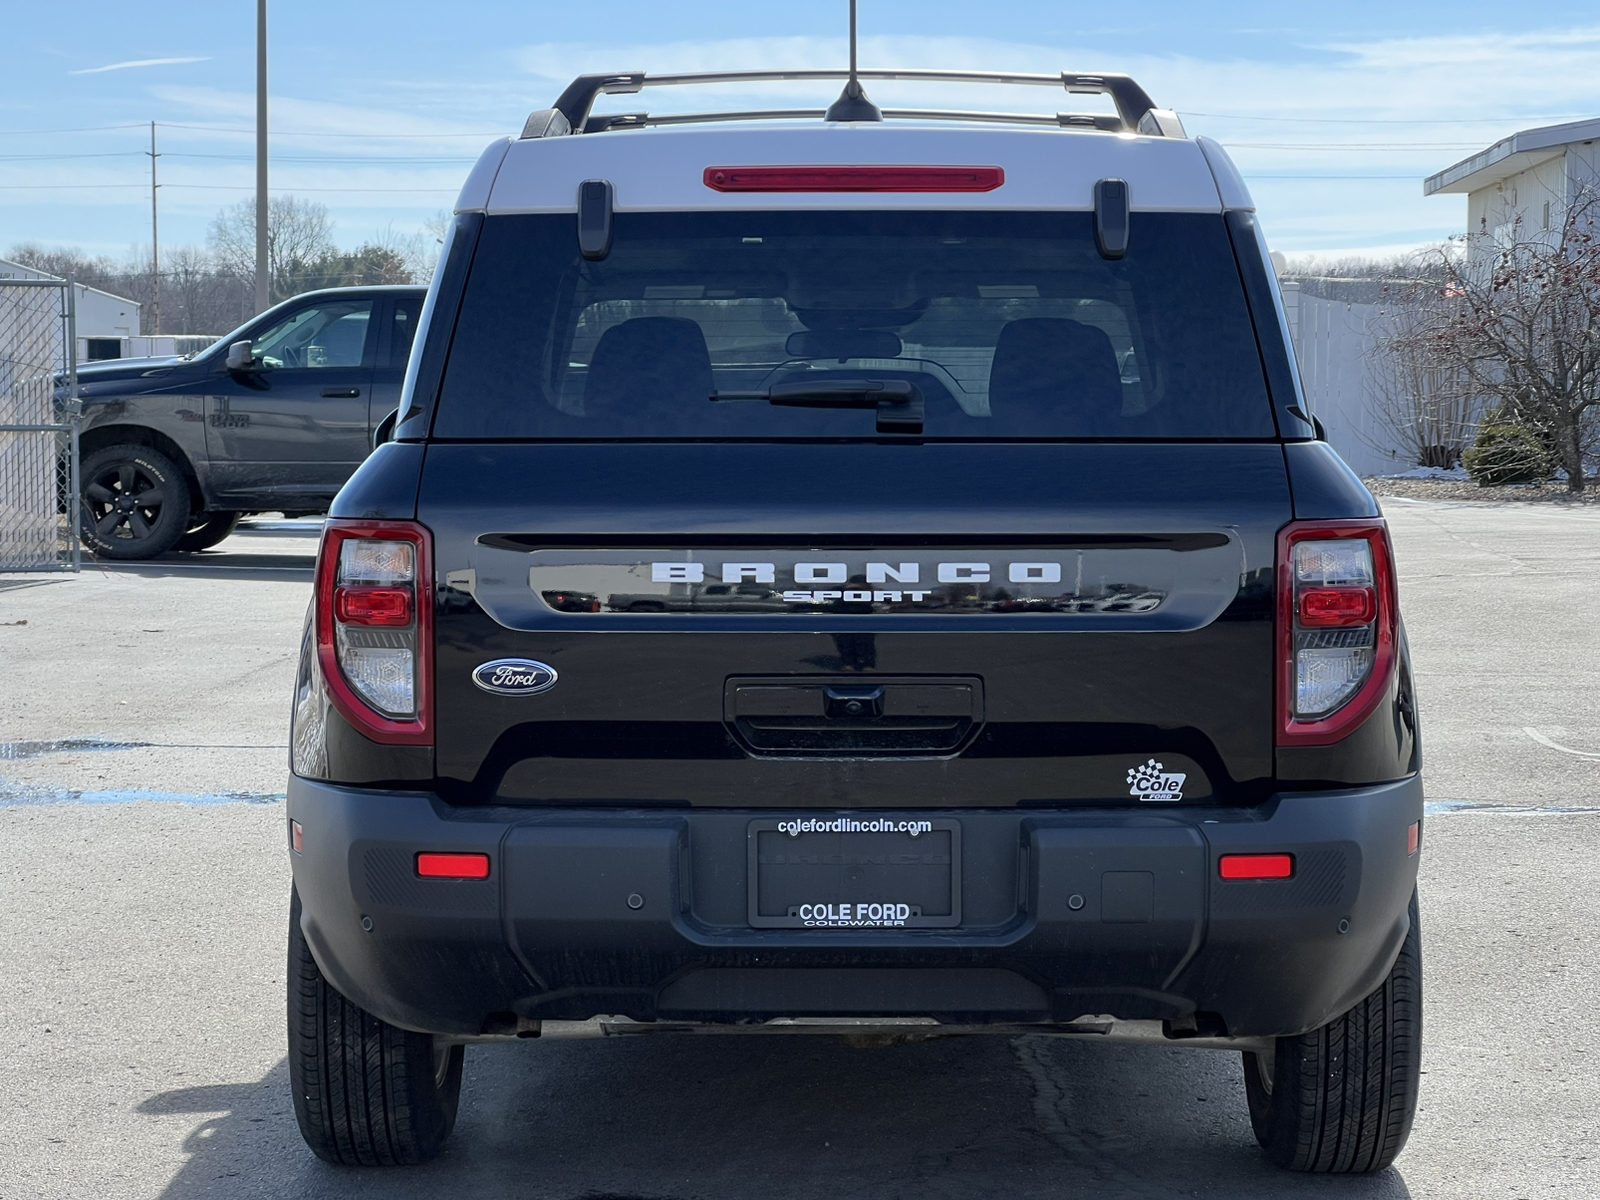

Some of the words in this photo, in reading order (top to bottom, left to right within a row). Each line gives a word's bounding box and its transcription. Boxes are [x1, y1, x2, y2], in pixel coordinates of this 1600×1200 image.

[651, 562, 1061, 583] BRONCO
[783, 590, 932, 602] SPORT
[491, 665, 537, 686] Ford
[1136, 776, 1179, 792] Cole
[778, 818, 932, 832] colefordlincoln.com
[800, 904, 851, 920] COLE
[857, 903, 910, 920] FORD
